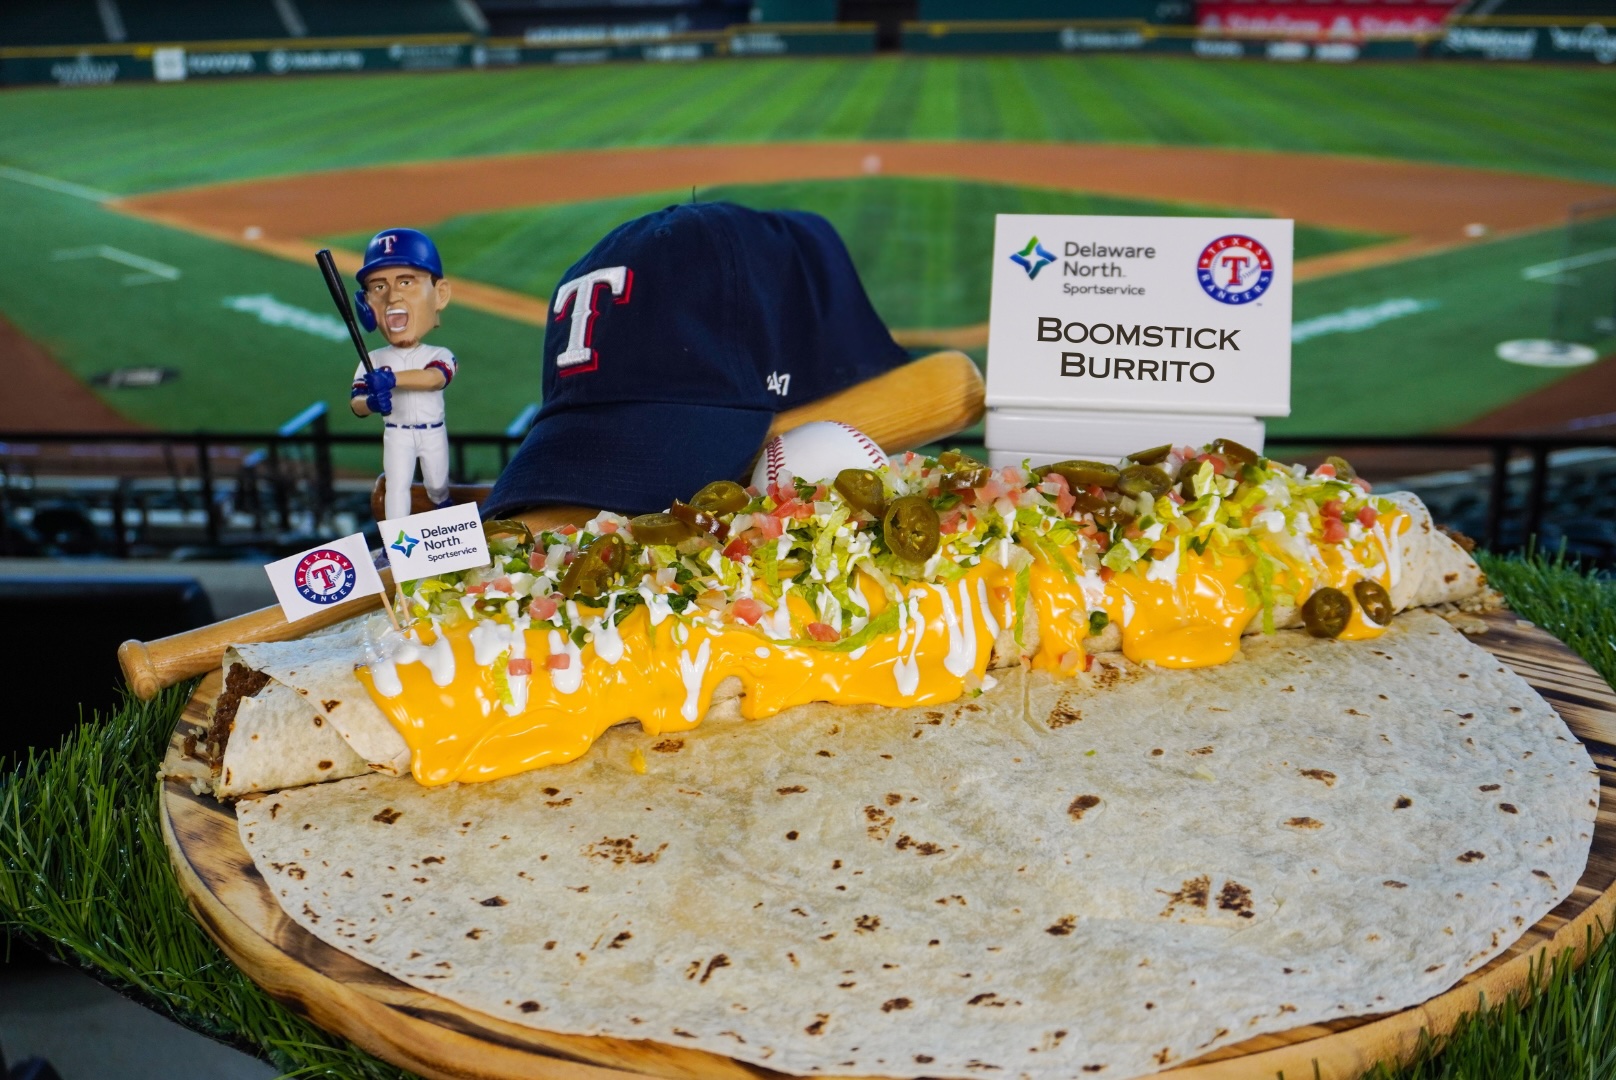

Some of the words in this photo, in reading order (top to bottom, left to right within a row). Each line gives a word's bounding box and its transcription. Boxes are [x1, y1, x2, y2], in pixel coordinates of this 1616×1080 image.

[378, 234, 397, 253] T
[1064, 241, 1157, 260] Delaware
[1207, 237, 1264, 256] TEXAS
[1063, 260, 1123, 278] North
[1221, 255, 1251, 287] T
[1063, 282, 1147, 297] Sportservice
[1201, 273, 1269, 303] RANGERS
[553, 266, 634, 377] T
[1036, 316, 1242, 351] BOOMSTICK
[1060, 351, 1216, 384] BURRITO
[420, 520, 478, 539] Delaware
[423, 535, 461, 552] North
[298, 552, 341, 573] TEXAS
[427, 546, 478, 563] Sportservice
[302, 573, 354, 602] RANGERS
[311, 564, 336, 591] T
